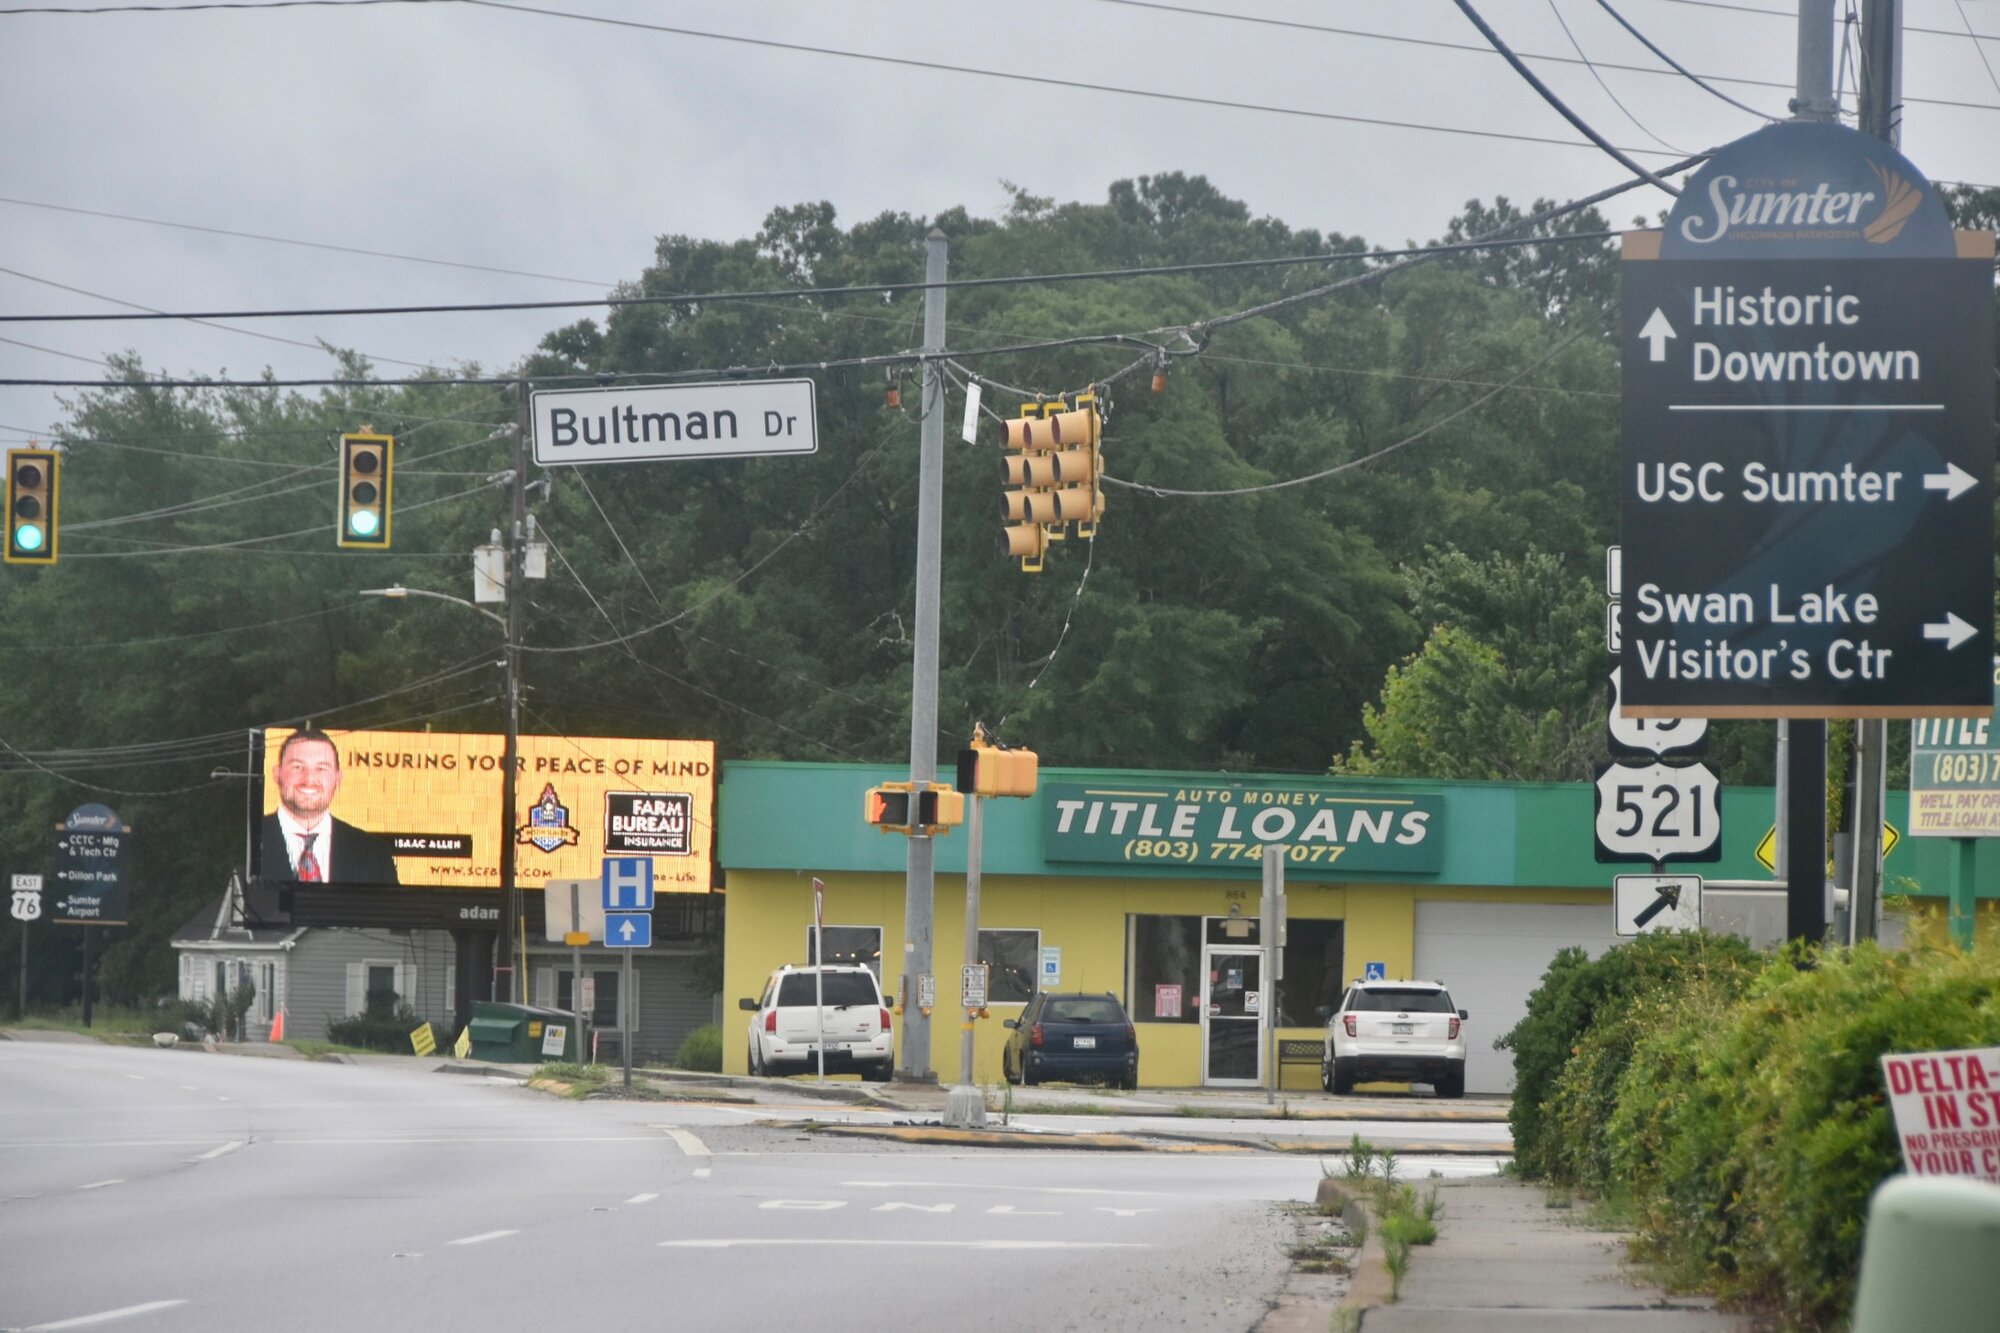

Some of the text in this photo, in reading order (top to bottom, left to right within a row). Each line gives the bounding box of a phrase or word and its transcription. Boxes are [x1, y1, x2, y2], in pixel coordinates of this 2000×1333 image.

[1681, 175, 1876, 244] Sumter
[1728, 231, 1793, 241] UNCOMMON
[1693, 285, 1860, 326] Historic
[1693, 341, 1920, 382] Downtown
[550, 404, 797, 447] Bultman Dr
[1637, 462, 1903, 503] USC Sumter
[1637, 583, 1879, 623] Swan Lake
[1637, 640, 1892, 679] Visitor's Ctr
[348, 751, 457, 770] INSURING
[536, 757, 605, 774] PEACE
[614, 759, 643, 775] OF
[652, 761, 710, 777] MIND
[1933, 753, 1988, 784] (803)
[1175, 790, 1320, 805] AUTO MONEY
[1919, 794, 1953, 809] WE'LL
[1955, 794, 1981, 809] PAY
[632, 799, 683, 817] FARM
[1615, 784, 1702, 837] 521
[67, 813, 107, 829] Sumter
[612, 816, 684, 832] BUREAU
[1055, 800, 1431, 845] TITLE LOANS
[1920, 812, 1953, 827] TITLE
[1953, 812, 1988, 829] LOAN
[69, 835, 94, 845] CCTC
[102, 836, 119, 848] Mfg
[394, 838, 461, 850] ISAAC ALLEN
[624, 836, 683, 848] INSURANCE
[69, 847, 117, 857] & Tech Ctr
[1124, 840, 1345, 863] (803) 7747077
[16, 877, 37, 887] EAST
[68, 871, 118, 882] Dillon Park
[609, 860, 646, 907] H
[67, 895, 101, 906] Sumter
[1226, 889, 1246, 900] 864
[16, 898, 36, 915] 76
[67, 906, 100, 917] Airport
[1922, 1093, 1962, 1130] IN
[1905, 1129, 2000, 1150] NO PRESCRI
[1910, 1150, 1976, 1176] YOUR
[757, 1199, 1165, 1217] ONLY
